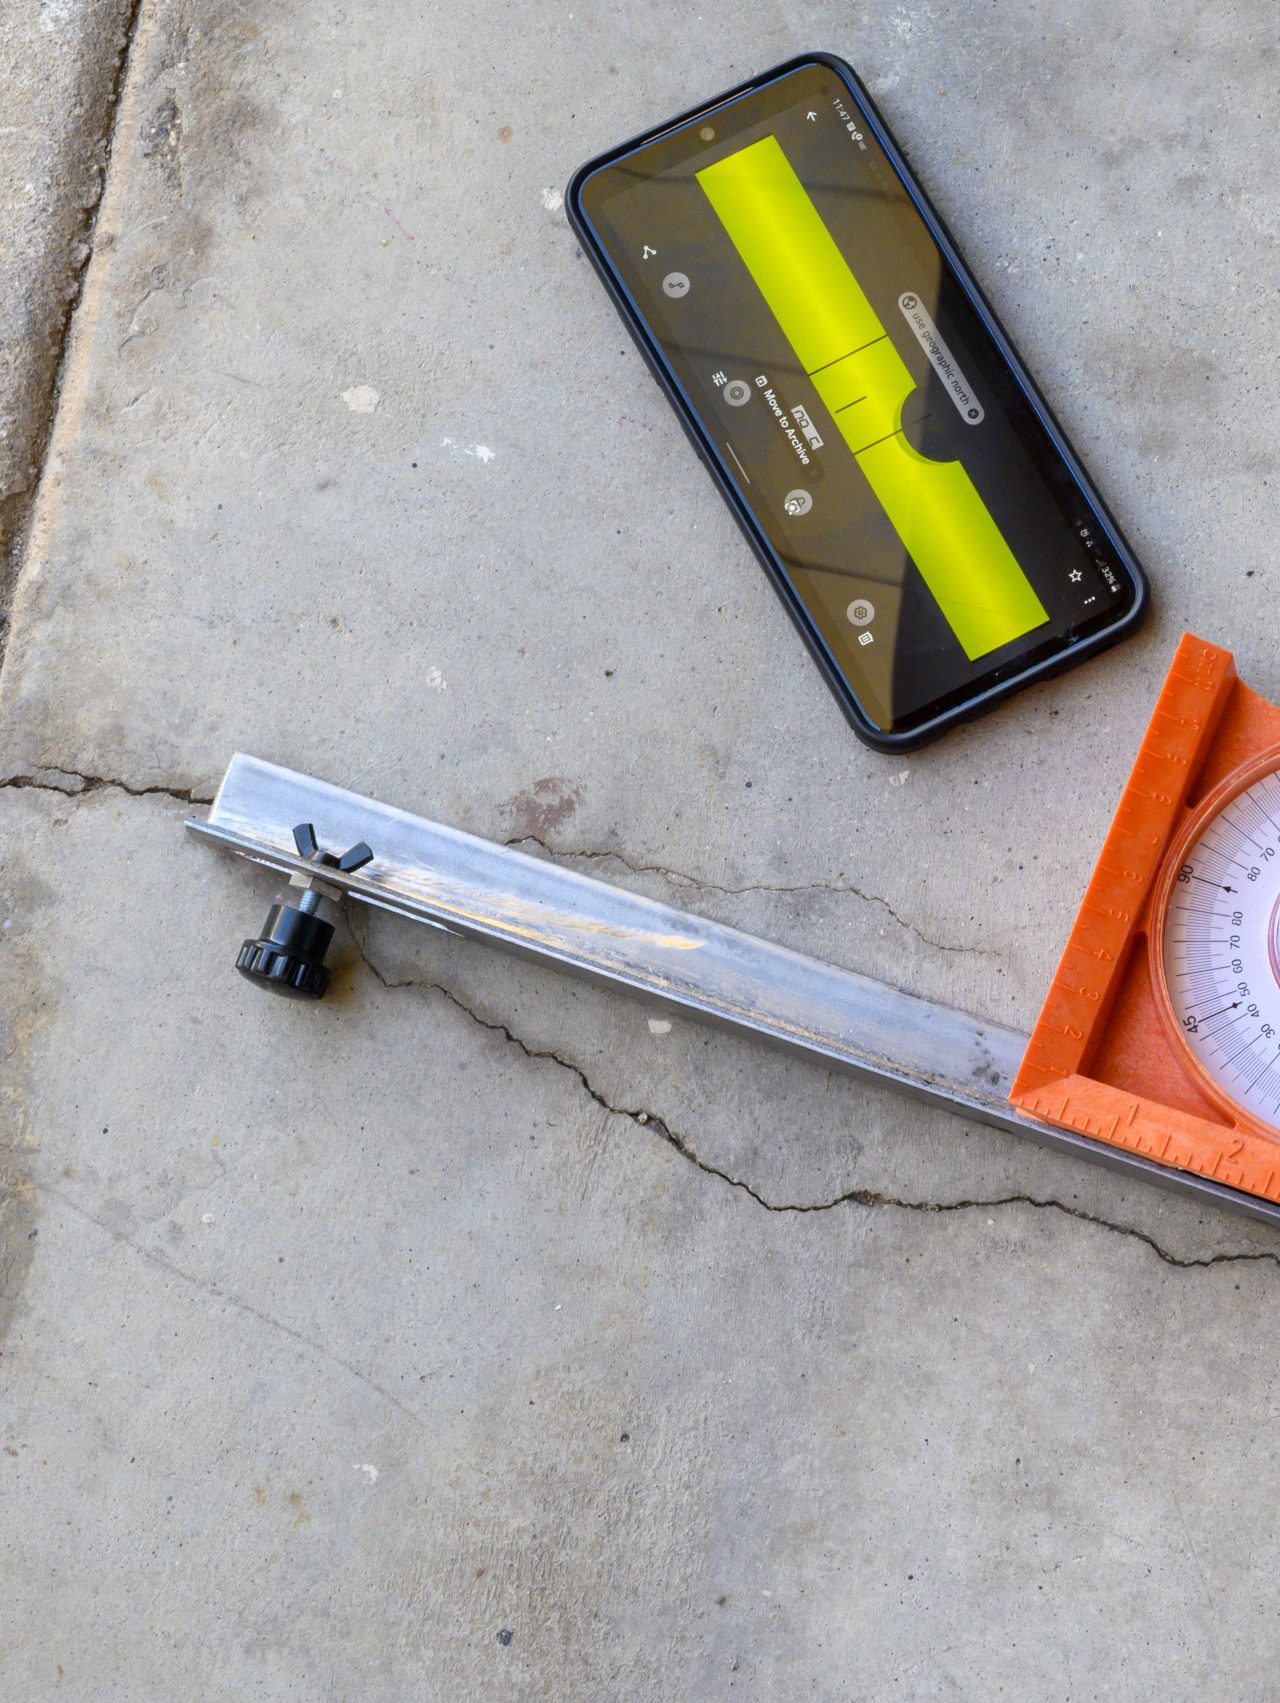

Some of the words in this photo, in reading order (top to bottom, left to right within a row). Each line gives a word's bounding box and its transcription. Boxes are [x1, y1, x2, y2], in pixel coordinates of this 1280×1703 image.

[832, 98, 850, 121] 11:47
[912, 313, 925, 329] use
[921, 331, 955, 380] geographic
[951, 379, 971, 406] north
[763, 389, 783, 417] Move
[779, 416, 789, 428] to
[785, 429, 810, 465] Archive
[1101, 566, 1116, 585] 32%
[1259, 847, 1275, 862] 70
[1177, 864, 1194, 884] 90
[1247, 866, 1261, 882] 80
[1231, 911, 1244, 926] 80
[1229, 935, 1241, 950] 70
[1231, 958, 1244, 974] 60
[1237, 981, 1250, 997] 50
[1247, 1003, 1260, 1018] 40
[1063, 1024, 1083, 1040] 2
[1182, 1015, 1199, 1034] 45
[1260, 1023, 1276, 1039] 30
[1127, 1102, 1140, 1126] 1
[1226, 1138, 1245, 1165] 2
